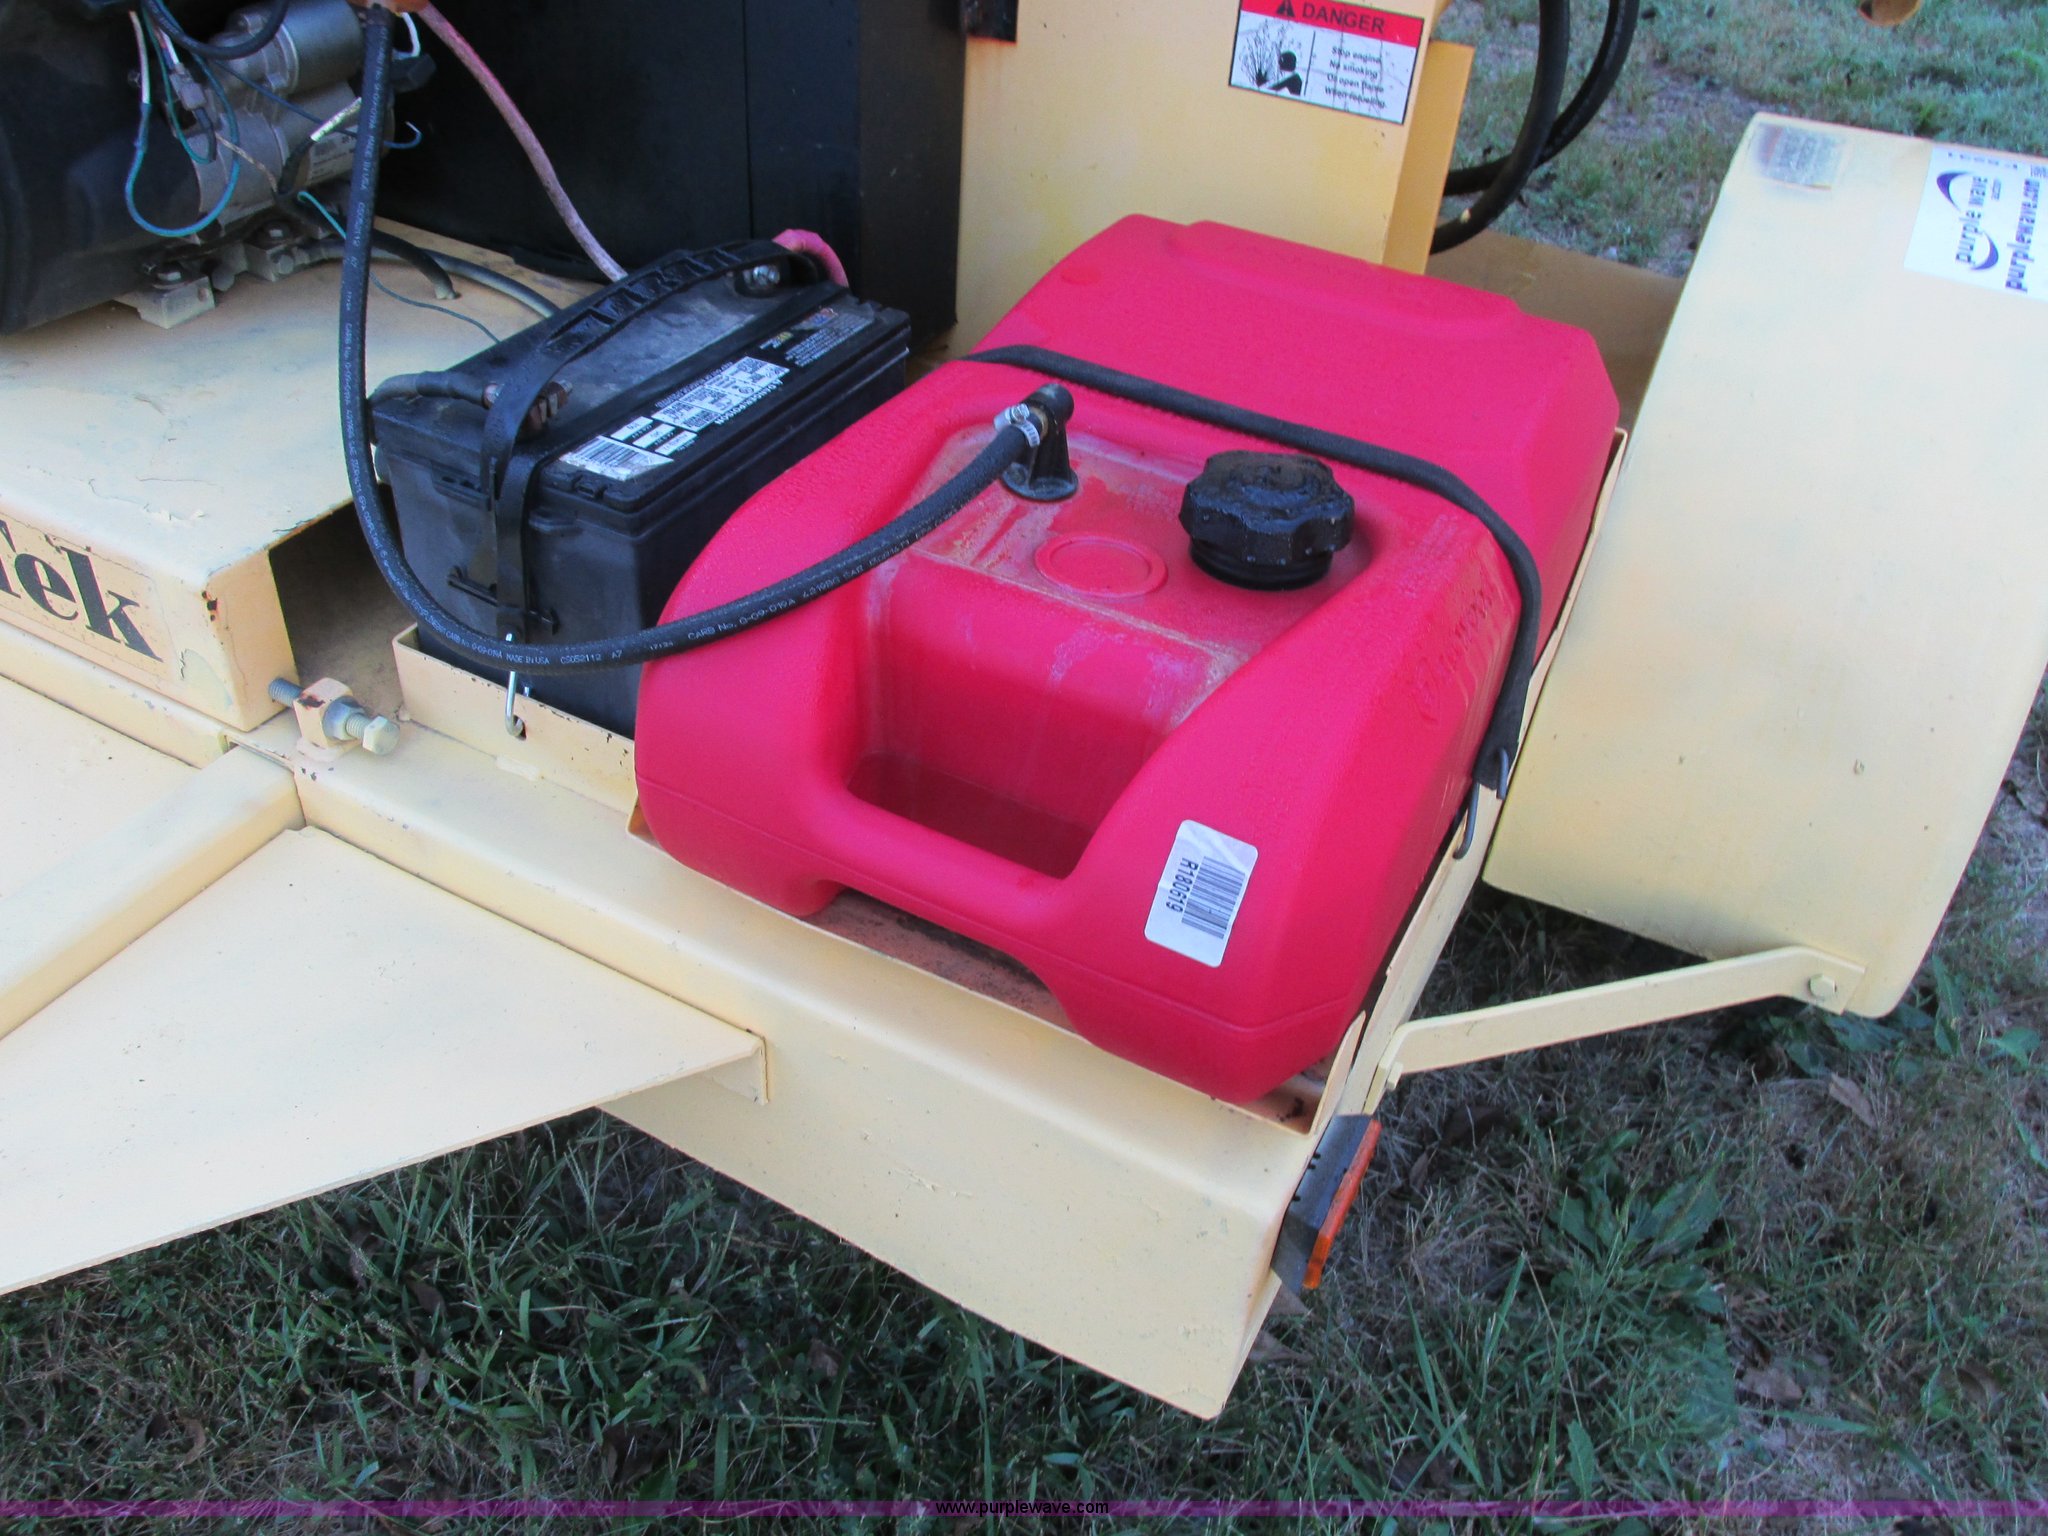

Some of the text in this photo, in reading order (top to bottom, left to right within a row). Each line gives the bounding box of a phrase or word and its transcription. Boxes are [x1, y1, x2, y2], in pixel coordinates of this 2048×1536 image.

[1302, 3, 1385, 34] DANGER
[1343, 63, 1378, 80] smoking
[1353, 52, 1381, 64] engine
[1339, 77, 1359, 88] open
[1955, 176, 1988, 265] purple wave
[505, 653, 522, 663] MADE
[534, 656, 550, 665] USA
[687, 625, 716, 640] CARB
[1166, 857, 1199, 913] R180619
